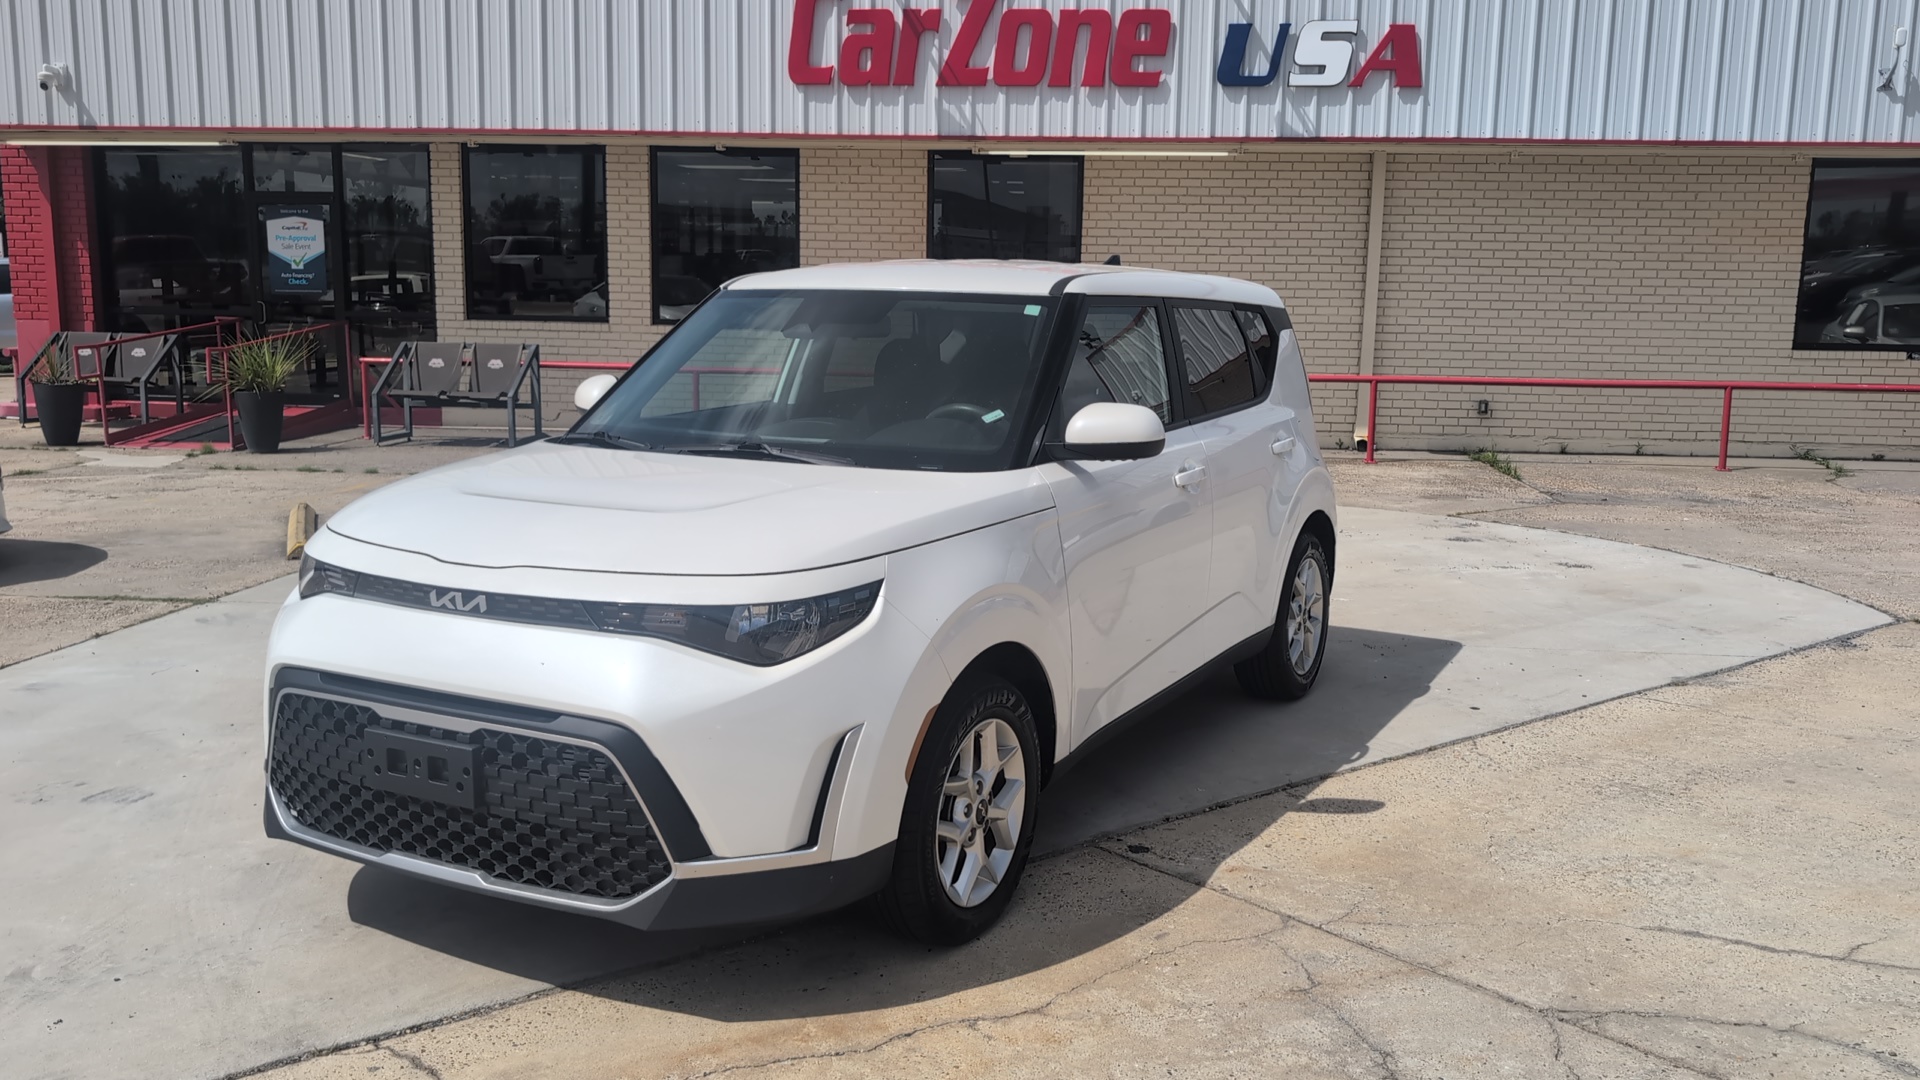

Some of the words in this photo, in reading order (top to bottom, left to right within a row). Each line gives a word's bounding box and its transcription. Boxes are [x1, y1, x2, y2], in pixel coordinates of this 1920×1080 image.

[787, 0, 1172, 88] CarZone
[1216, 19, 1423, 88] USA
[275, 234, 317, 242] Pre-Approval
[429, 589, 487, 613] KIA
